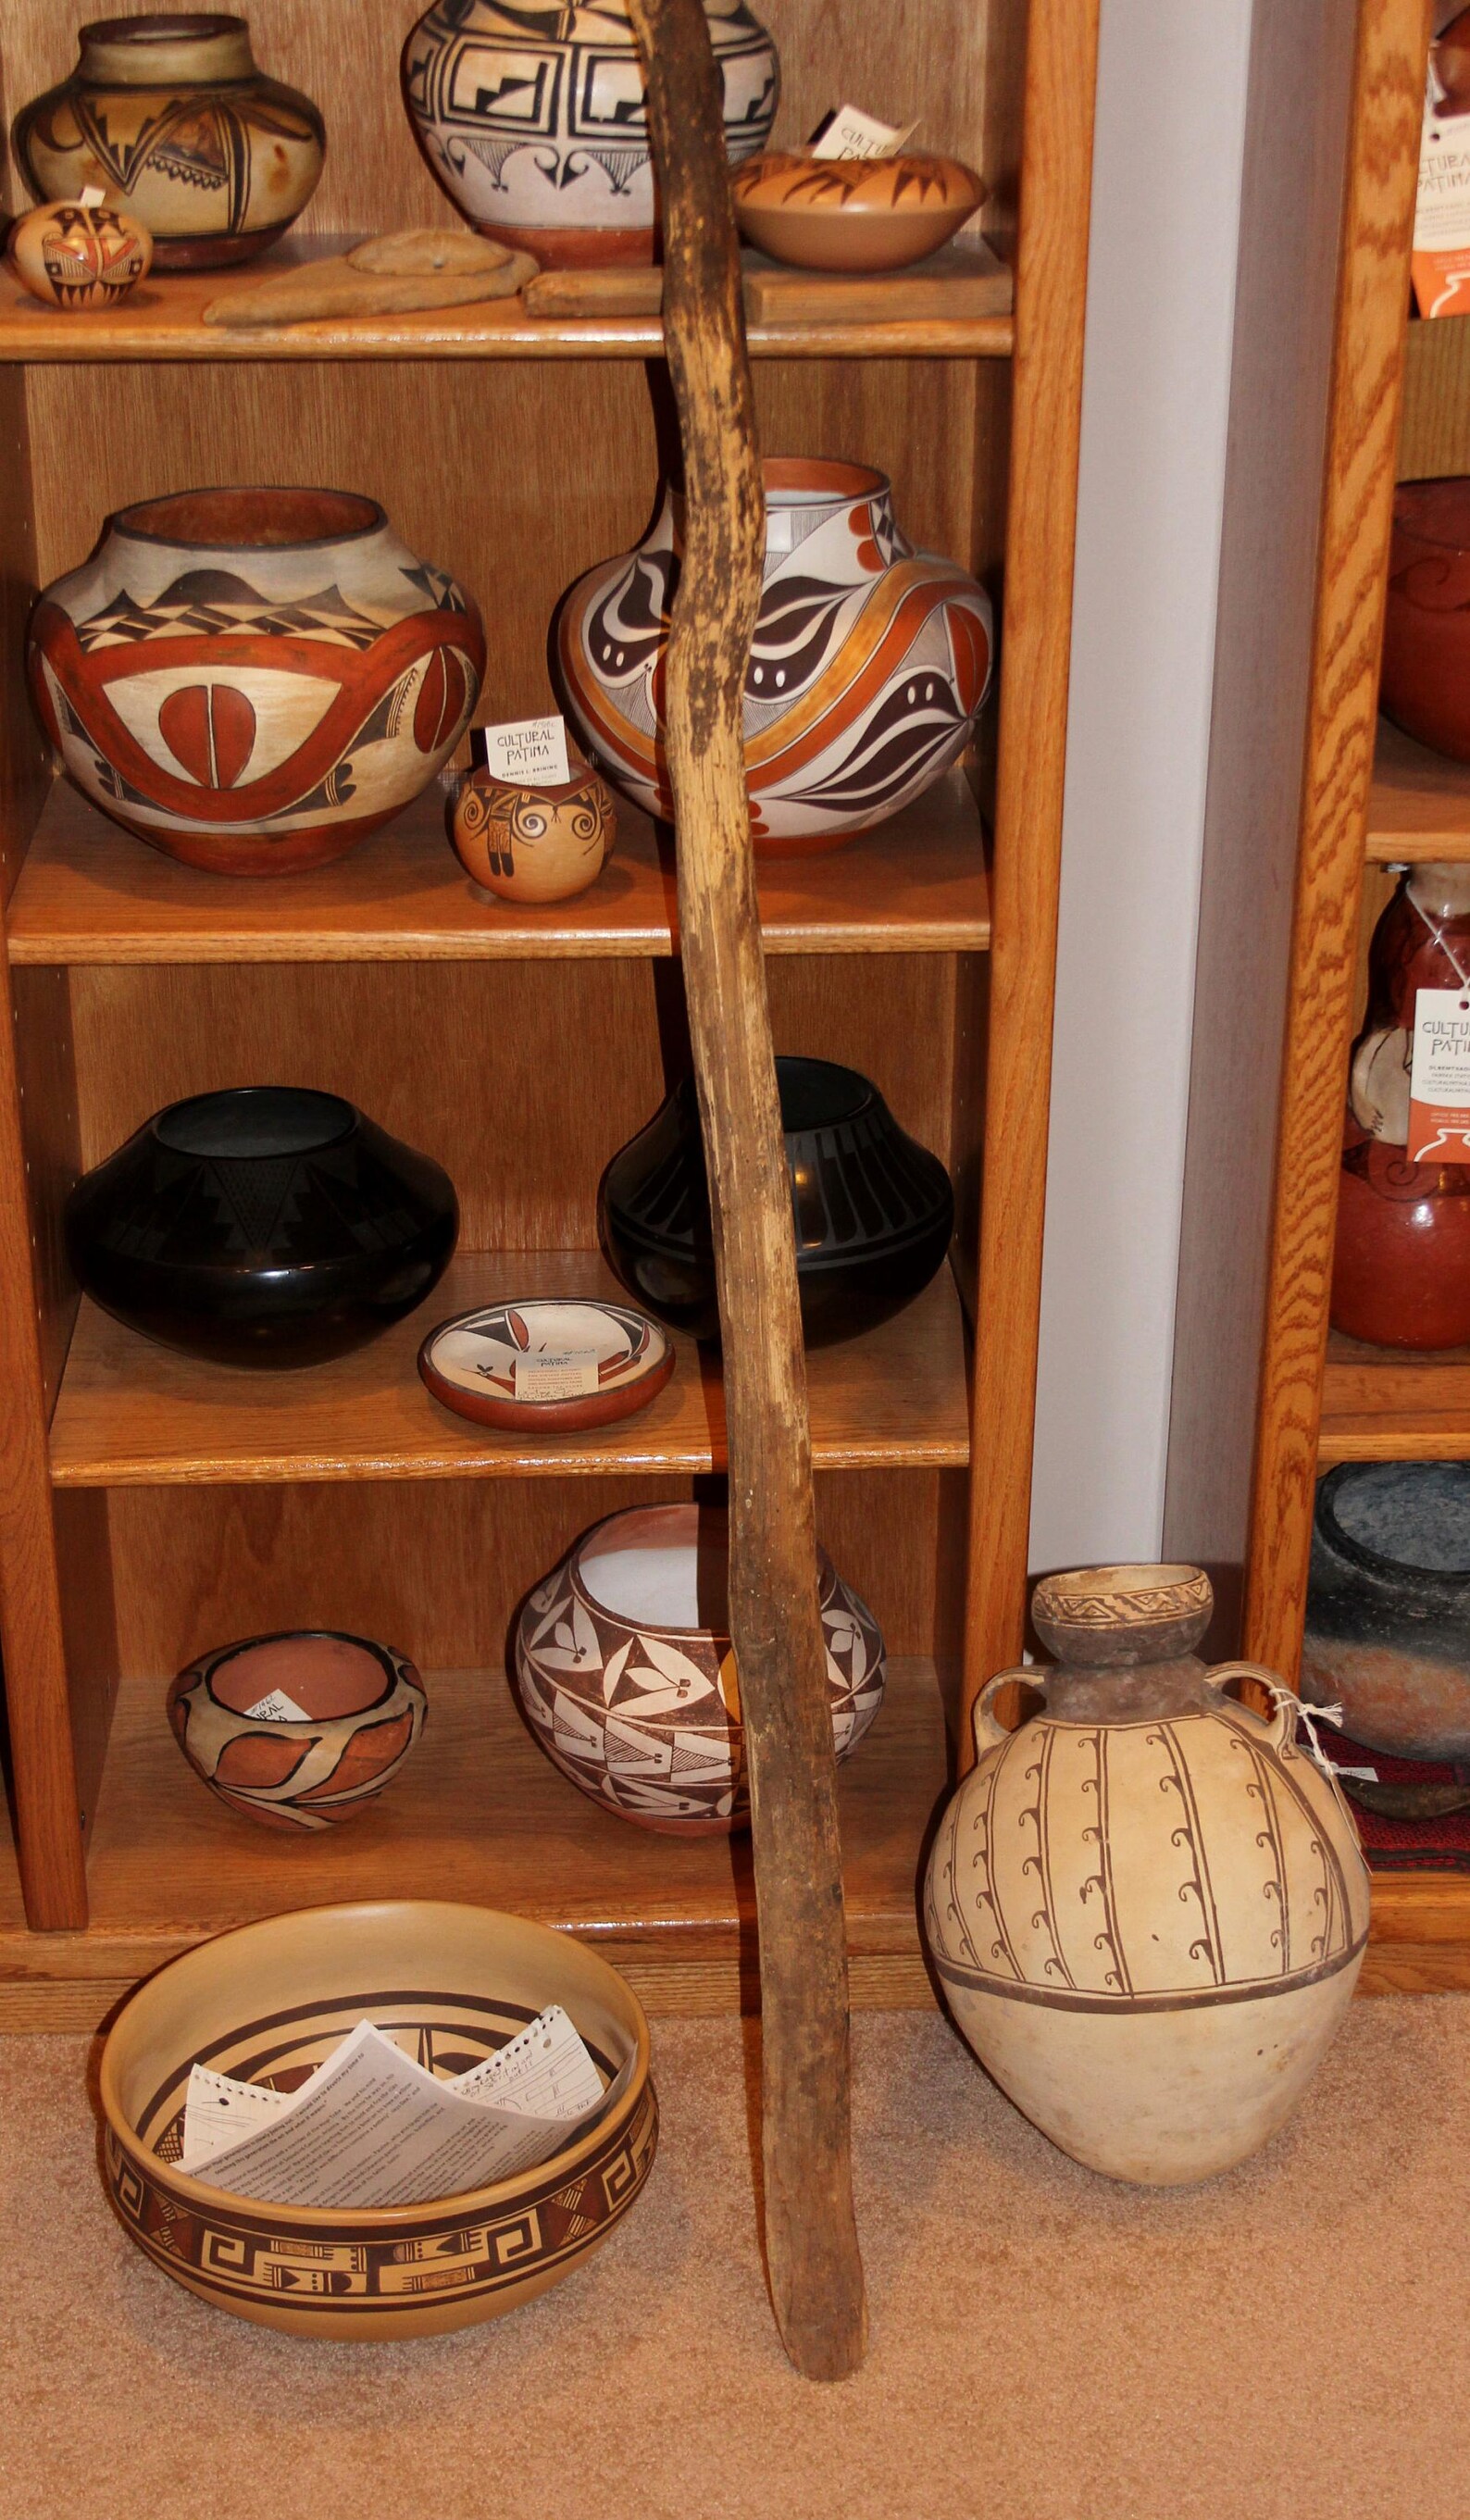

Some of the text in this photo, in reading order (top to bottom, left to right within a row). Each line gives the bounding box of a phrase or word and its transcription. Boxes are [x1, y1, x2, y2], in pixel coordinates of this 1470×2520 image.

[841, 128, 888, 156] CULTU
[497, 729, 554, 748] CULTURAL
[506, 744, 549, 766] PATINA
[1422, 1021, 1470, 1038] CULTU
